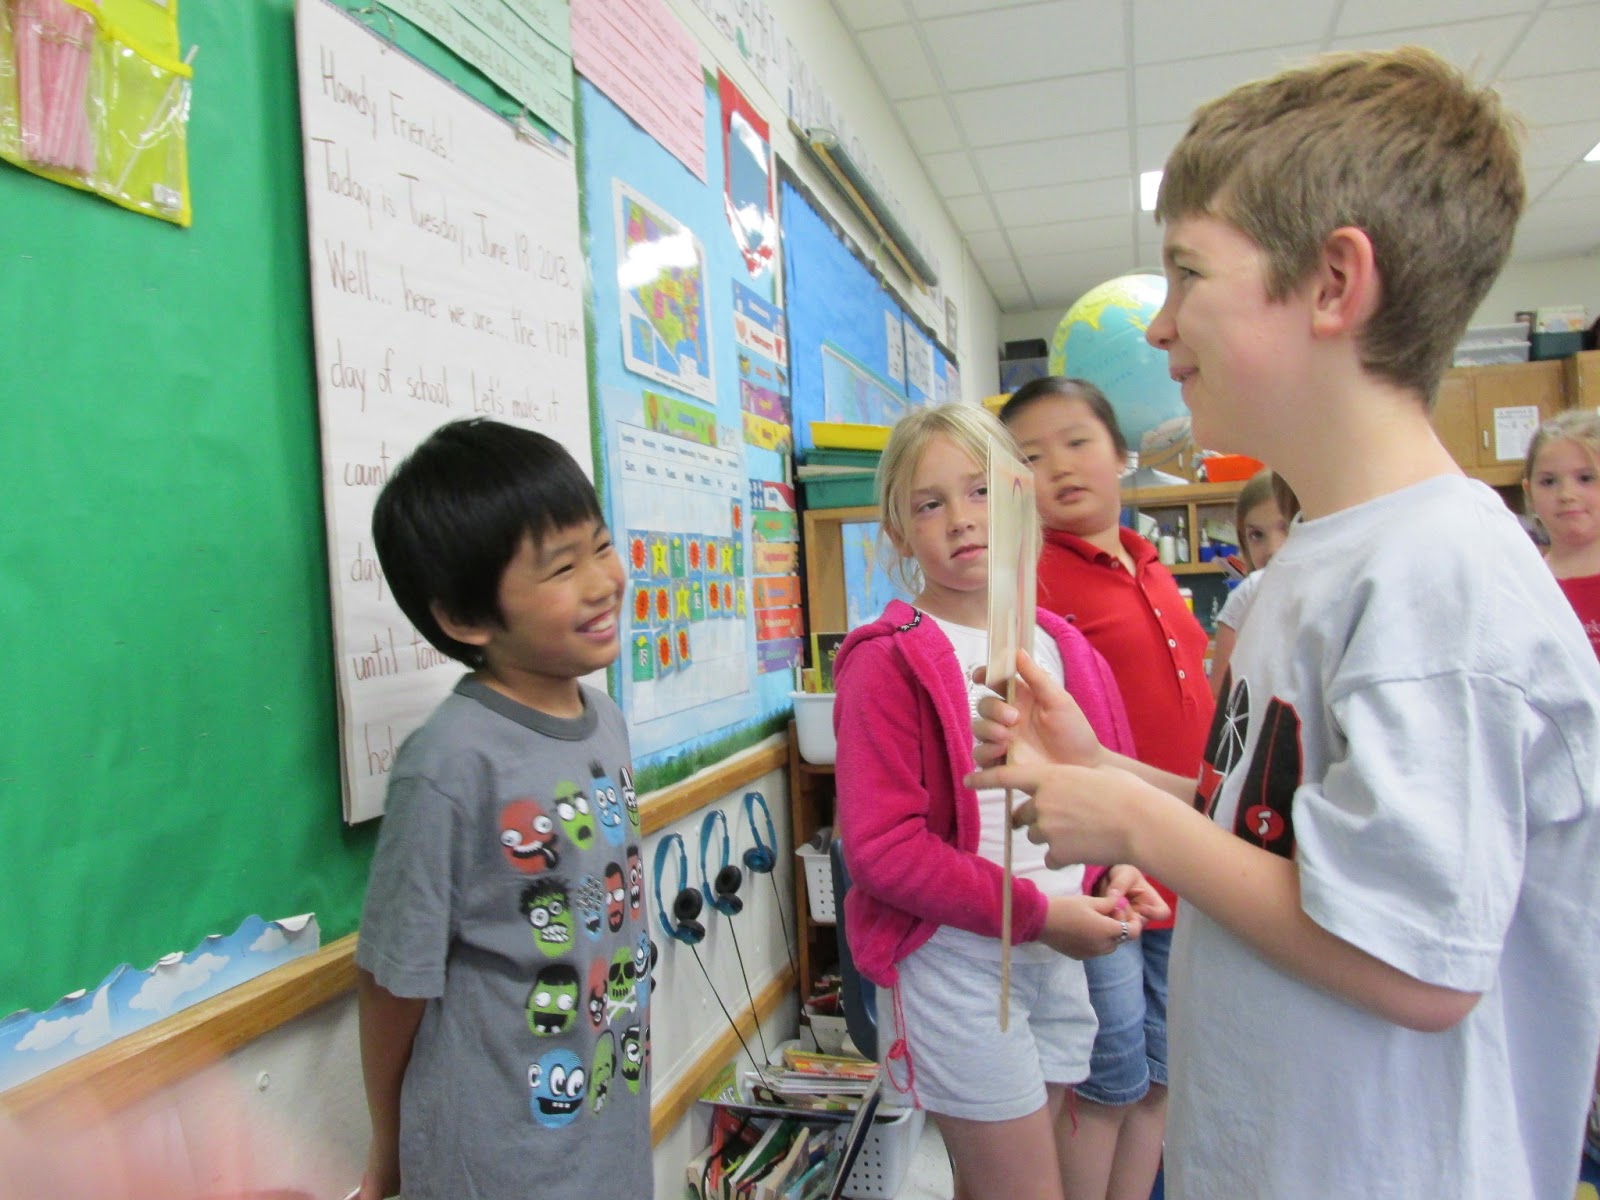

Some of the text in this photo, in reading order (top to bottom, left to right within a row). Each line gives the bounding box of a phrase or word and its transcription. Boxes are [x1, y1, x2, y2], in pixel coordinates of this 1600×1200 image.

[319, 44, 378, 141] Howdy
[311, 136, 374, 231] Today
[380, 184, 398, 219] is
[398, 172, 471, 266] Tuesday,
[471, 211, 510, 266] June
[400, 264, 438, 319] here
[449, 304, 466, 328] we
[511, 305, 537, 348] the
[330, 338, 367, 413] day
[377, 347, 395, 394] of
[471, 368, 505, 415] Let's
[511, 385, 542, 422] make
[546, 386, 560, 421] it
[343, 440, 391, 487] count
[350, 541, 384, 602] day
[353, 627, 450, 681] until tomo
[364, 721, 400, 777] hel
